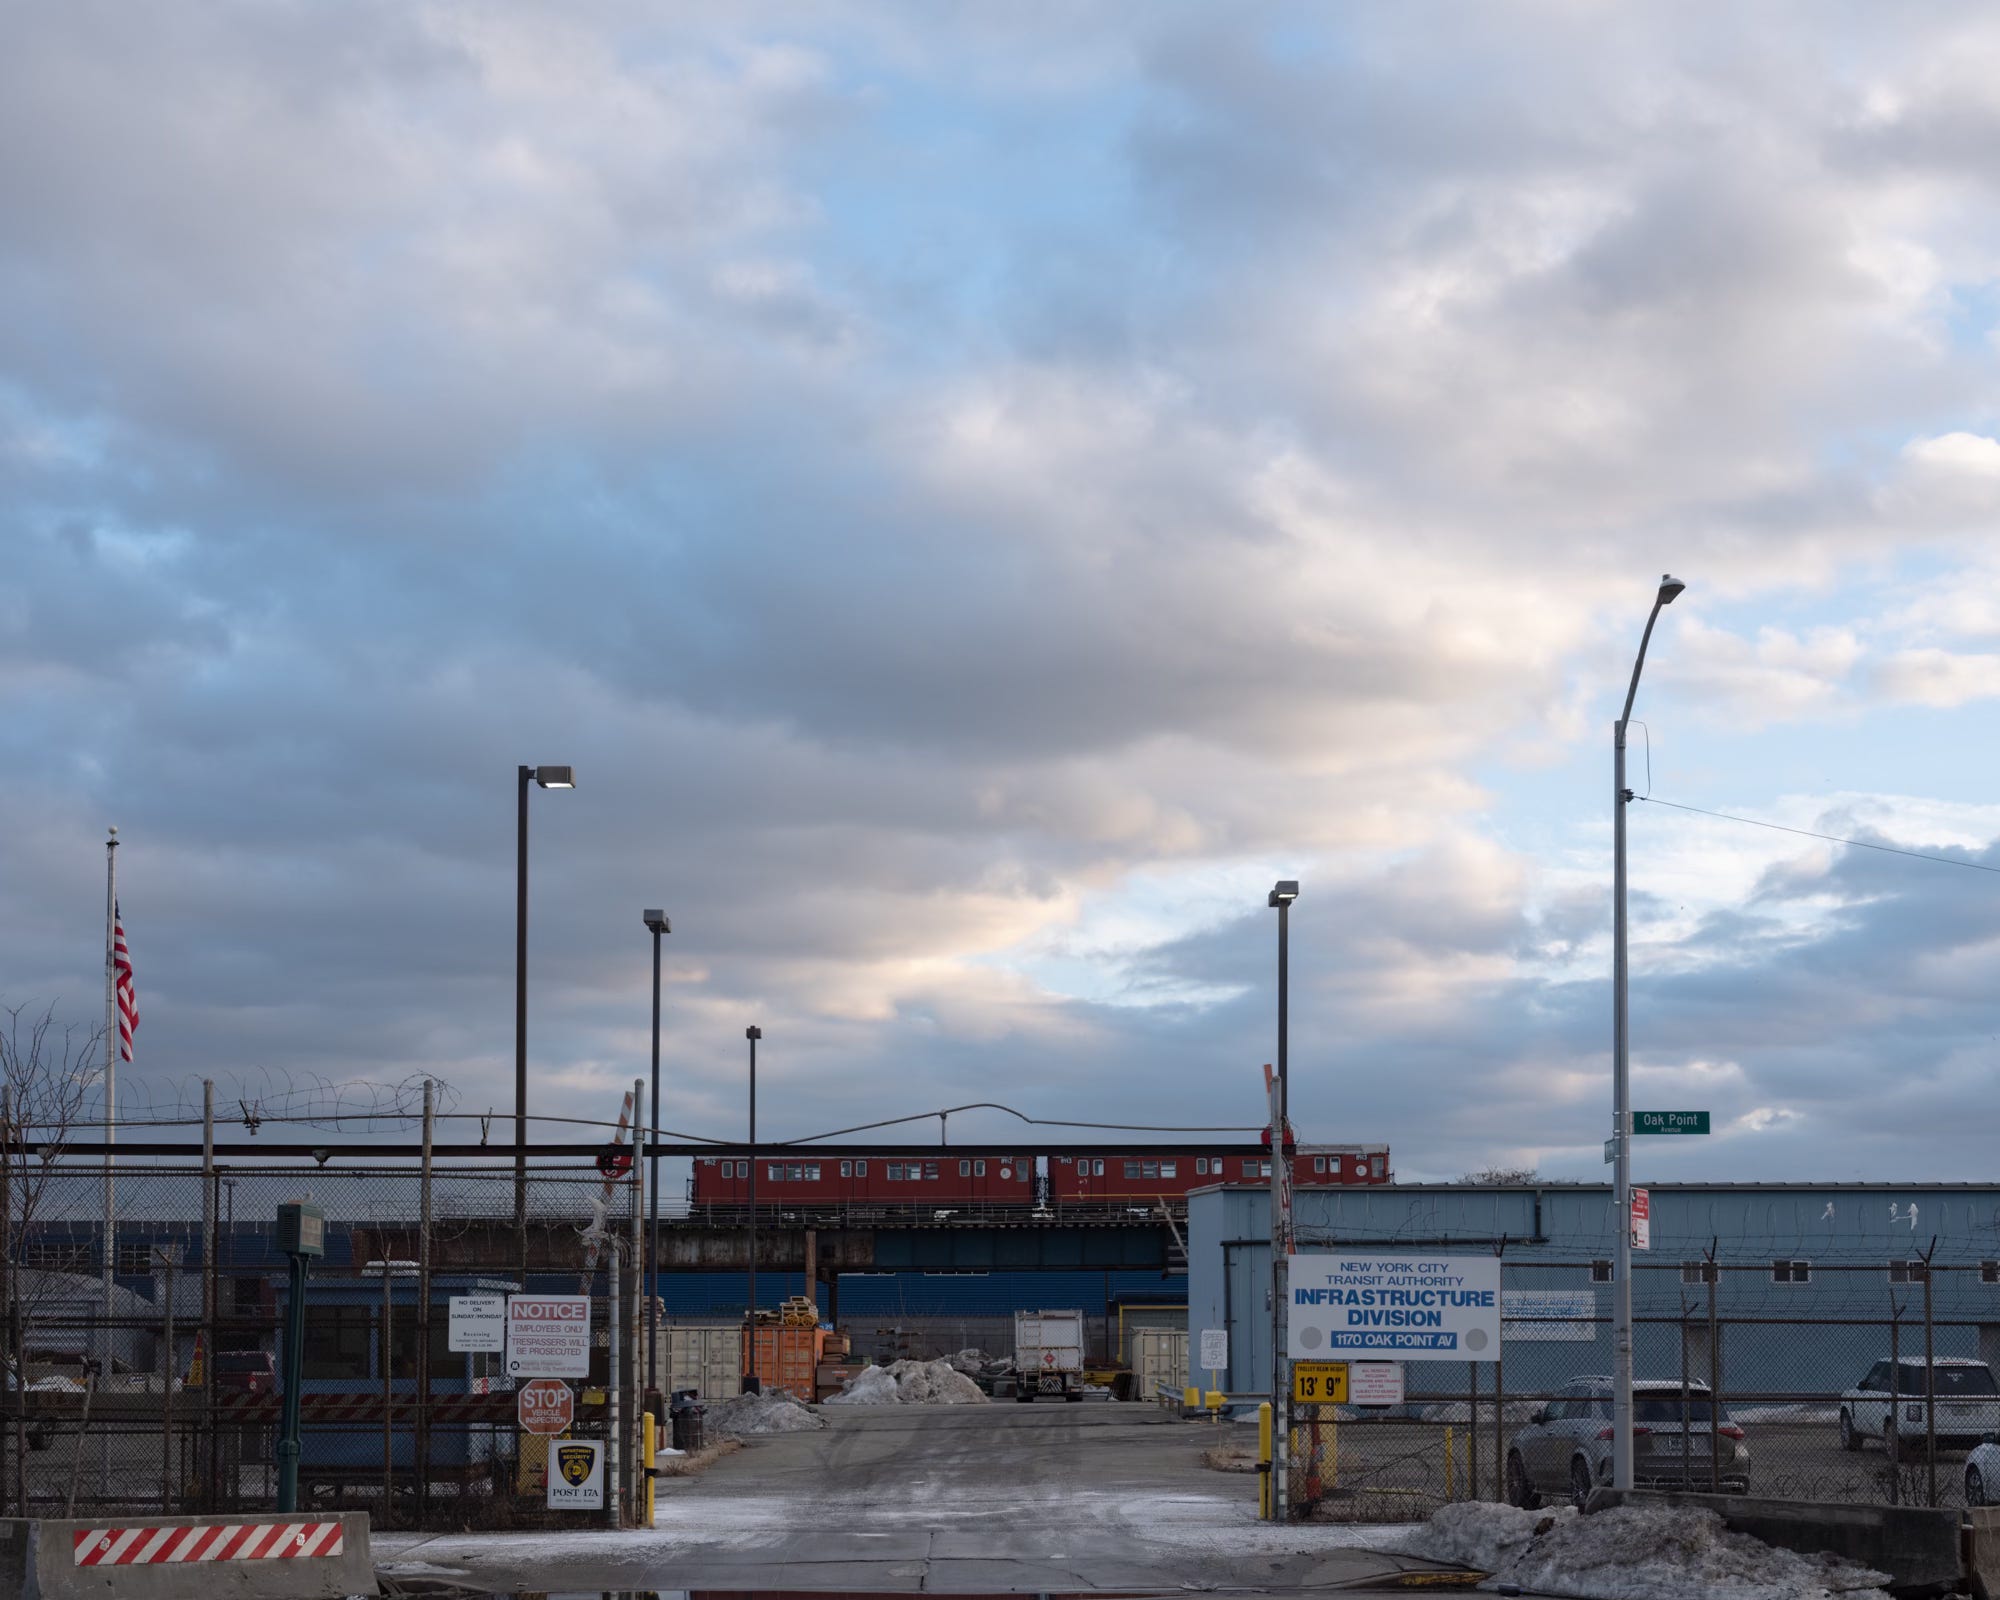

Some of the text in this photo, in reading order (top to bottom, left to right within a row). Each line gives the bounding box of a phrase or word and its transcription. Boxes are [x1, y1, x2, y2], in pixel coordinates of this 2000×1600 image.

[1643, 1113, 1698, 1126] Oak Point
[1340, 1262, 1449, 1273] NEW YORK CITY
[1325, 1274, 1464, 1287] TRANSIT AUTHORITY
[1294, 1288, 1495, 1307] INFRASTRUCTURE
[513, 1303, 584, 1319] NOTICE
[1347, 1309, 1442, 1327] DIVISION
[514, 1324, 583, 1334] EMPLOYEES ONLY
[512, 1338, 587, 1347] TRESPASSERS WILL
[1335, 1334, 1454, 1347] 1170 OAK POINT AV
[516, 1347, 582, 1356] BE PROSECUTED
[1300, 1377, 1318, 1396] 13'
[524, 1388, 569, 1408] STOP
[525, 1416, 566, 1424] INSPECTION
[553, 1488, 599, 1497] POST 17A
